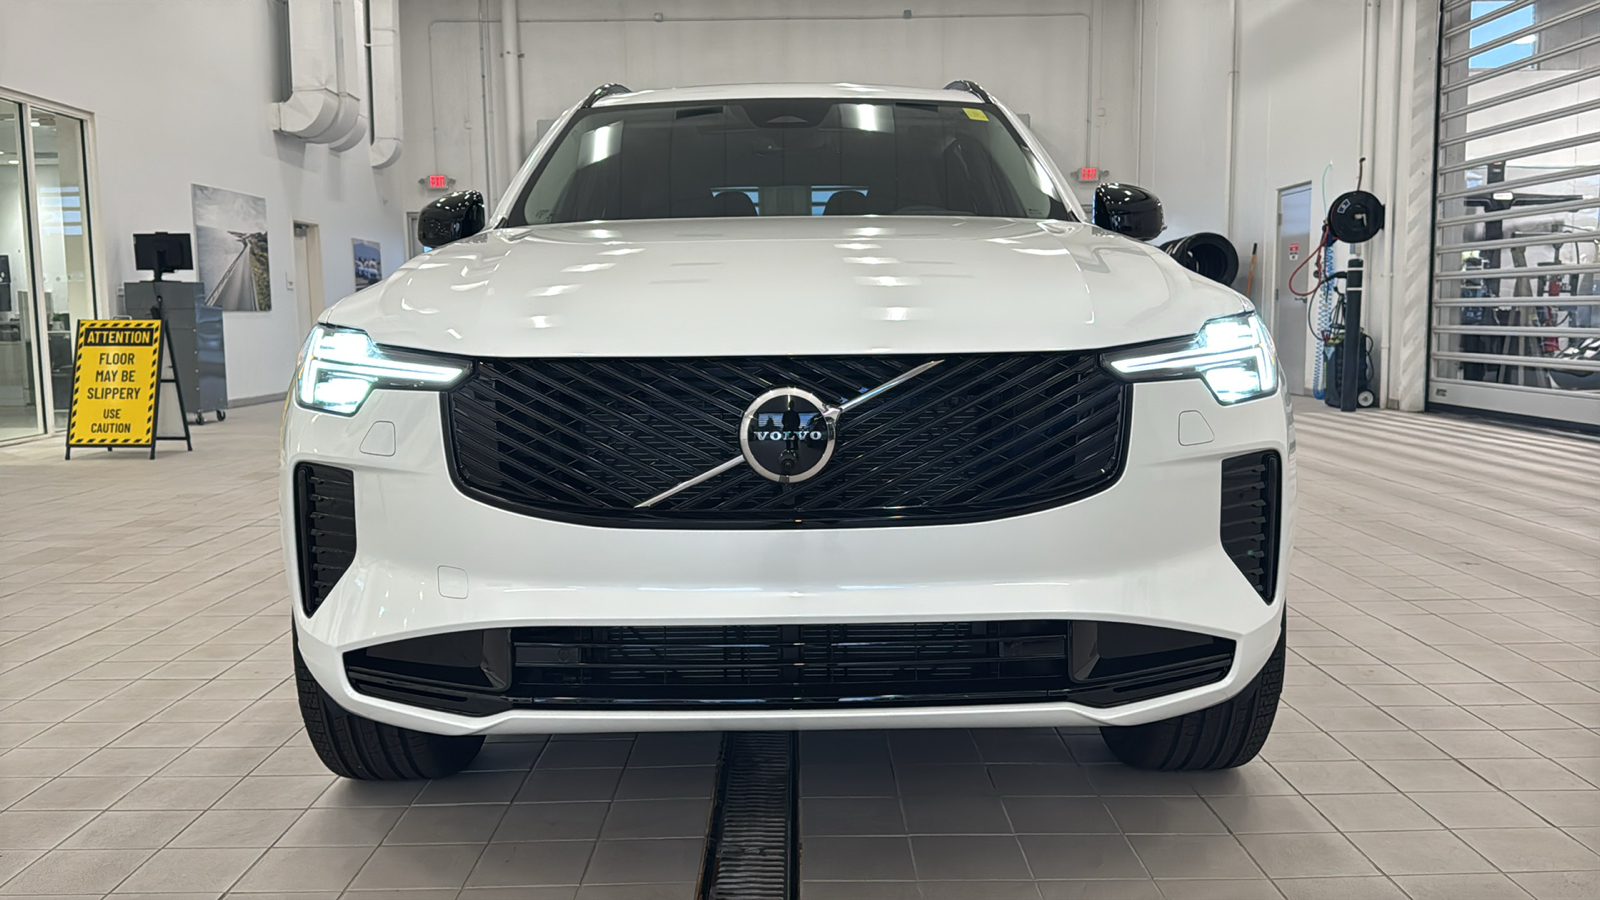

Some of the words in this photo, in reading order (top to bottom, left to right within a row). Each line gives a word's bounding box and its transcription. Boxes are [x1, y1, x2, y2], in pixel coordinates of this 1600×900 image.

[429, 175, 445, 188] EXIT
[87, 330, 150, 344] ATTENTION
[99, 353, 135, 365] FLOOR
[95, 370, 118, 382] MAY
[121, 370, 135, 382] BE
[87, 387, 141, 400] SLIPPERY
[103, 409, 121, 419] USE
[90, 423, 131, 433] CAUTION
[753, 430, 822, 441] VOLVO
